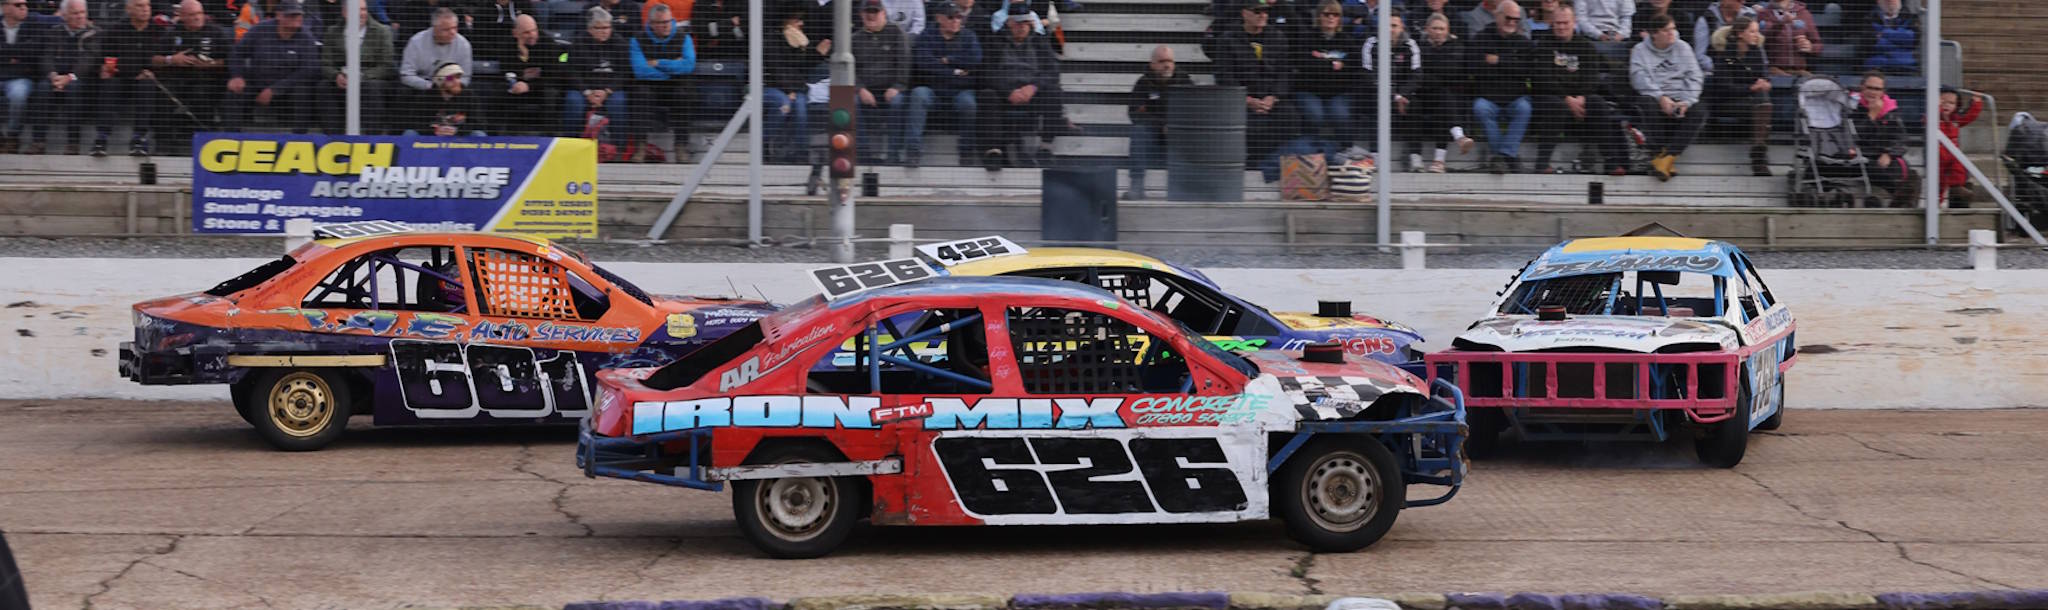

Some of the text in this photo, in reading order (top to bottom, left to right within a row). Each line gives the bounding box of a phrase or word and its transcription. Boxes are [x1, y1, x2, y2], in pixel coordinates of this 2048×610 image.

[199, 139, 395, 175] GEACH
[360, 166, 511, 185] HAULAGE
[203, 187, 285, 200] Haulage
[311, 181, 501, 199] AGGREGATES
[203, 203, 364, 218] Small Aggregate
[203, 218, 281, 230] Stone &
[936, 236, 1010, 262] 422
[813, 258, 931, 297] 626
[534, 325, 642, 343] SERVICES
[389, 338, 592, 418] 601
[720, 356, 760, 392] AR
[1130, 393, 1273, 412] CONCRETE
[632, 395, 881, 436] IRON
[875, 403, 928, 420] FTM
[924, 397, 1127, 429] MIX
[933, 437, 1250, 514] 626
